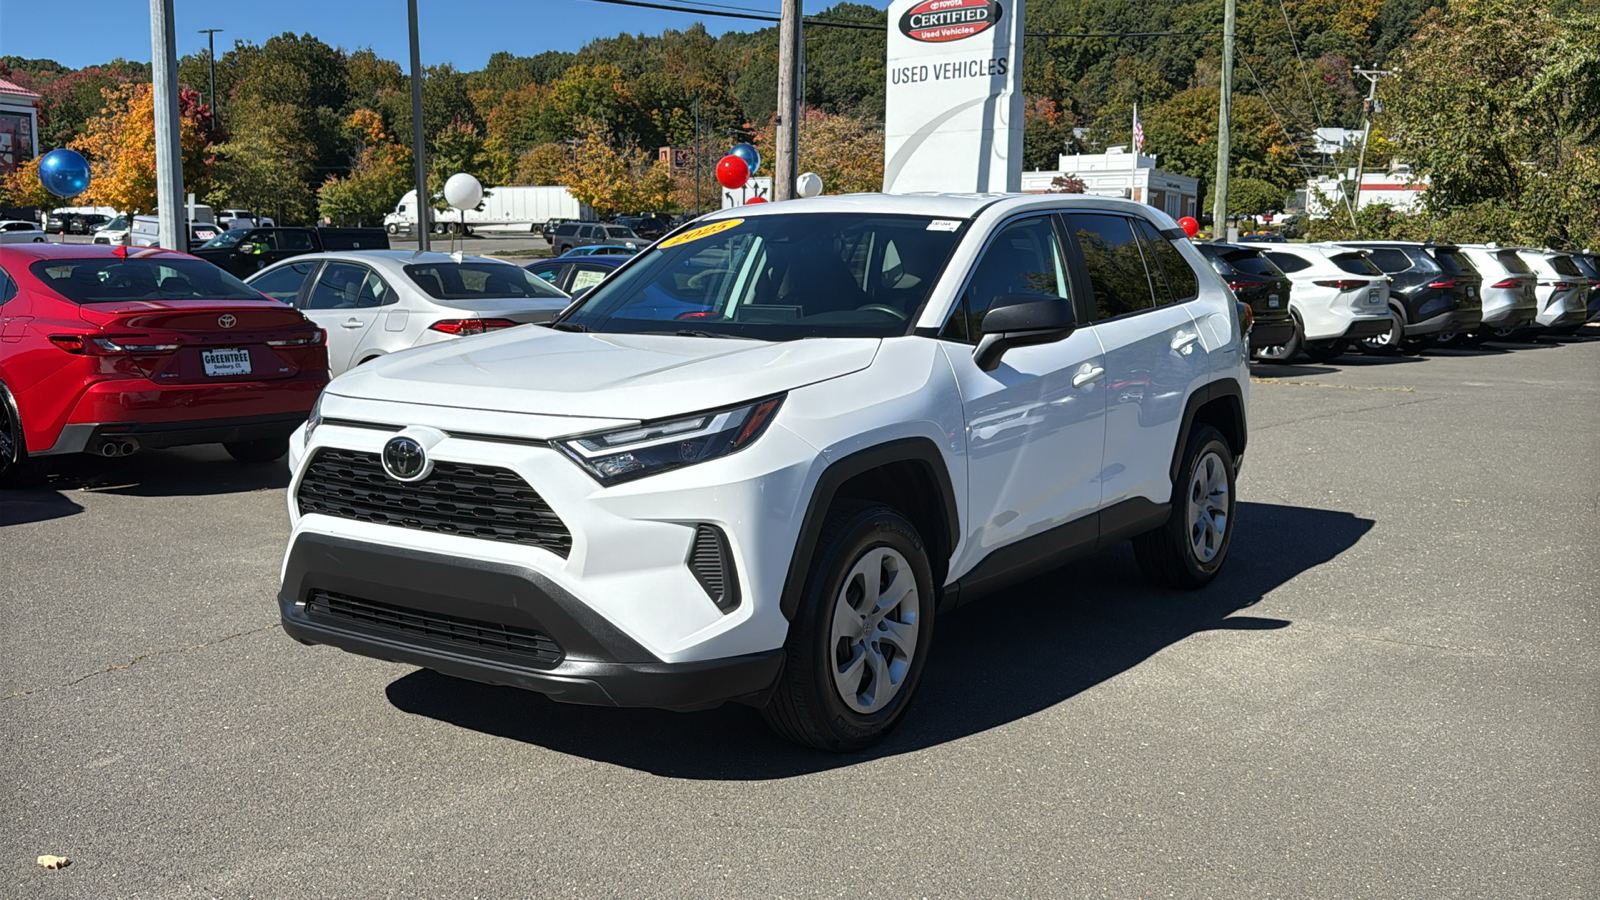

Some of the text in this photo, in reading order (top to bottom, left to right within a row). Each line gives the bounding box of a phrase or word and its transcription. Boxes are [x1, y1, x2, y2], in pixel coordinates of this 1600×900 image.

[939, 0, 963, 8] TOYOTA
[910, 9, 988, 28] CERTIFIED
[921, 27, 974, 38] Used Vehicles
[892, 57, 1007, 84] USED VEHICLES
[670, 221, 731, 245] 2025
[205, 352, 248, 364] GREENTREE
